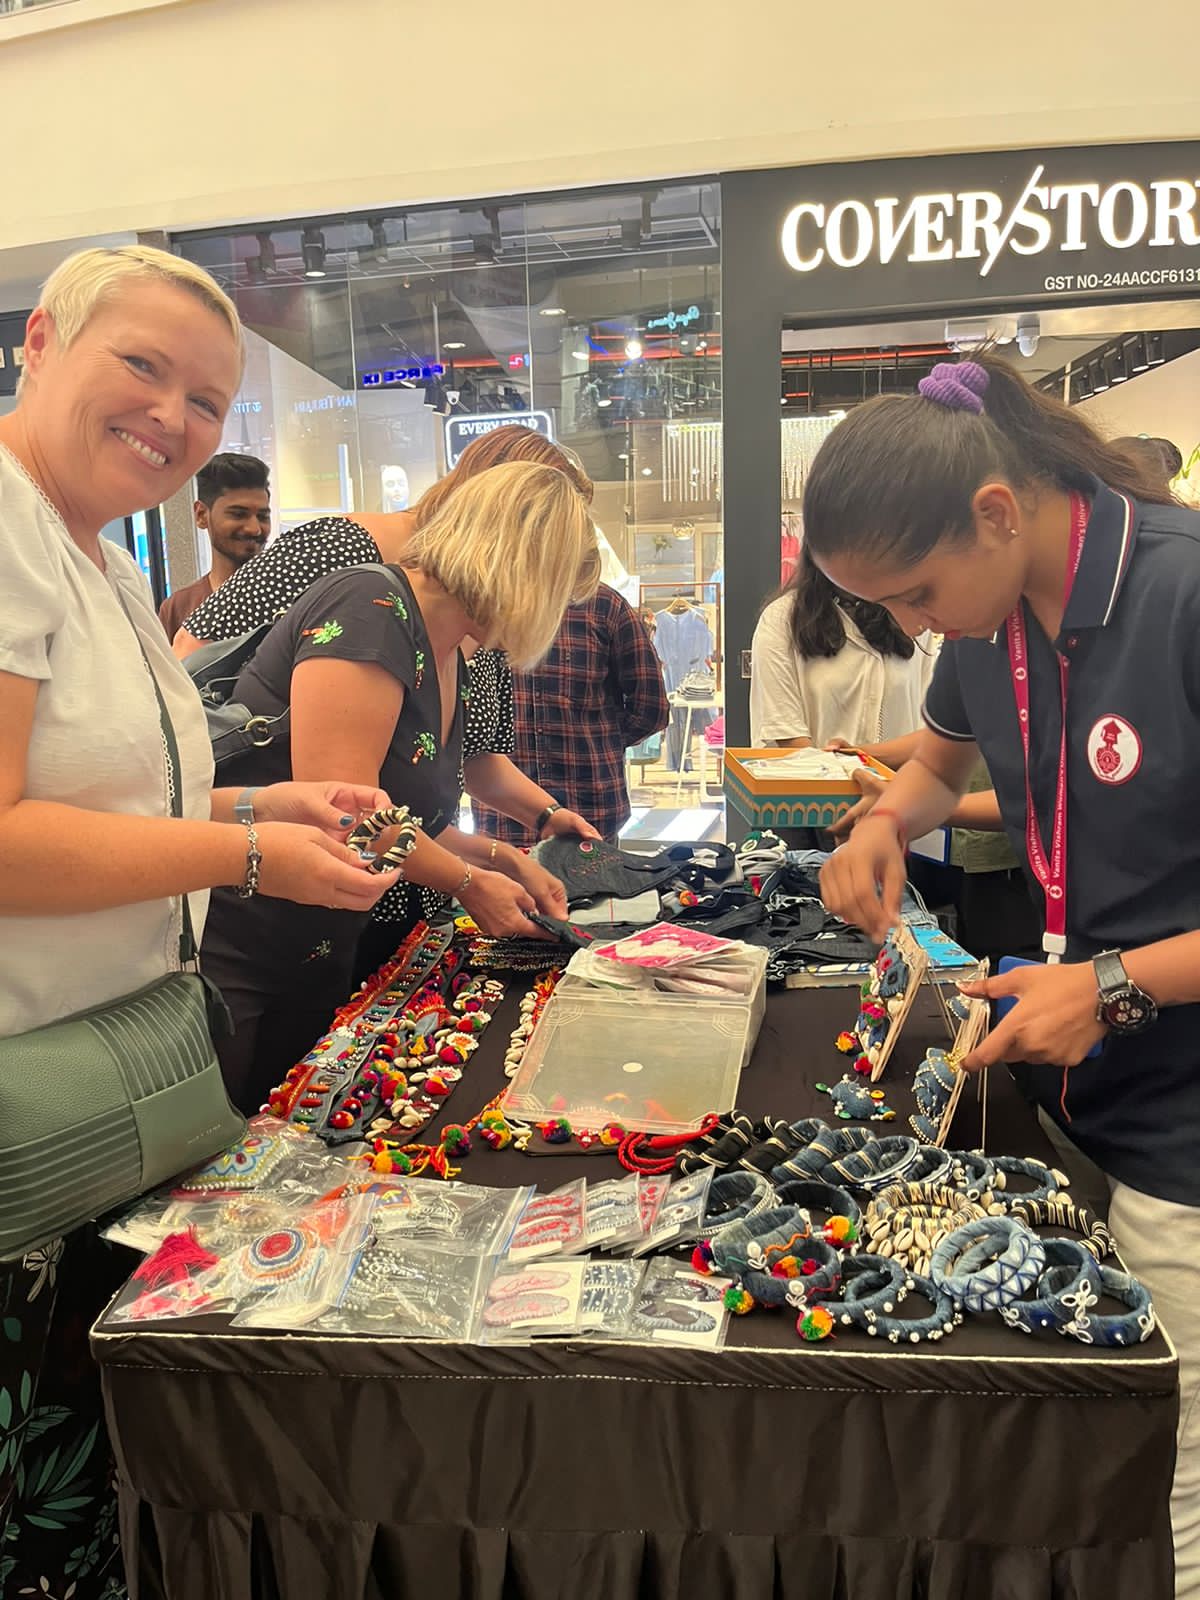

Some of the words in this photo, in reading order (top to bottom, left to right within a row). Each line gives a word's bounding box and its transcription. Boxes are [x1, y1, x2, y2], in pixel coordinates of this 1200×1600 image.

[781, 165, 1200, 277] COVER/STOR
[1045, 276, 1074, 291] GST
[458, 420, 500, 435] EVERY
